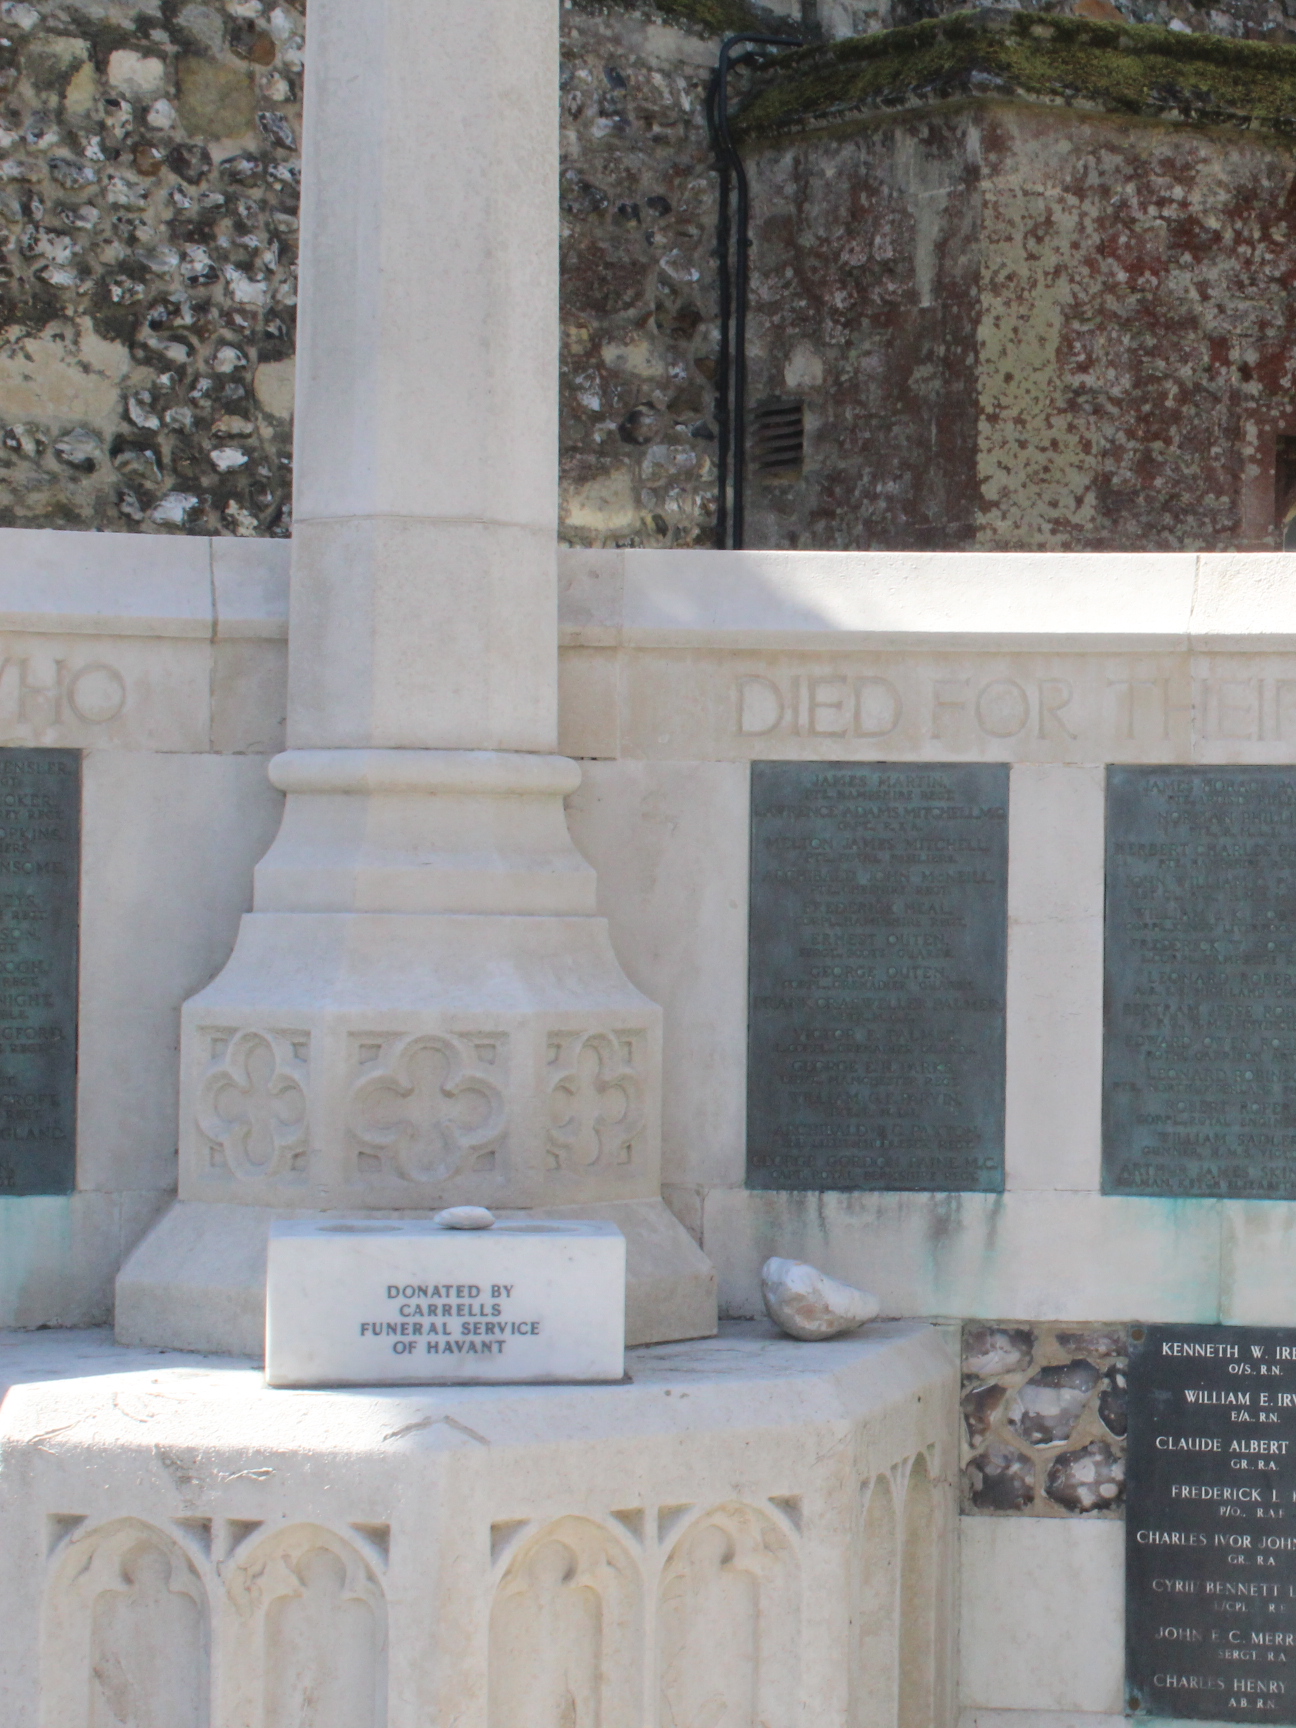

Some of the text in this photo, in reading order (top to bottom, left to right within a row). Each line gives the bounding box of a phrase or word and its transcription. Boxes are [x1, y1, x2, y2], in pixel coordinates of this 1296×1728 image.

[0, 661, 126, 725] HO
[734, 674, 905, 740] DIED
[930, 678, 1074, 742] FOR
[388, 1285, 513, 1298] DONATED BY
[400, 1304, 501, 1317] CARRELLS
[361, 1322, 539, 1336] FUNERAL SERVICE
[393, 1341, 505, 1354] OF HAVANT
[1163, 1343, 1238, 1357] KENNETH
[1251, 1346, 1268, 1358] W.
[1261, 1365, 1284, 1375] R.N.
[1185, 1390, 1250, 1405] WILLIAM
[1260, 1393, 1273, 1405] E.
[1260, 1412, 1280, 1422] R.N.
[1156, 1437, 1221, 1451] CLAUDE
[1230, 1440, 1288, 1454] ALBERT
[1172, 1486, 1261, 1501] FREDERICK
[1137, 1531, 1206, 1545] CHARLES
[1215, 1535, 1251, 1547] IVOR
[1234, 1679, 1286, 1693] HENRY
